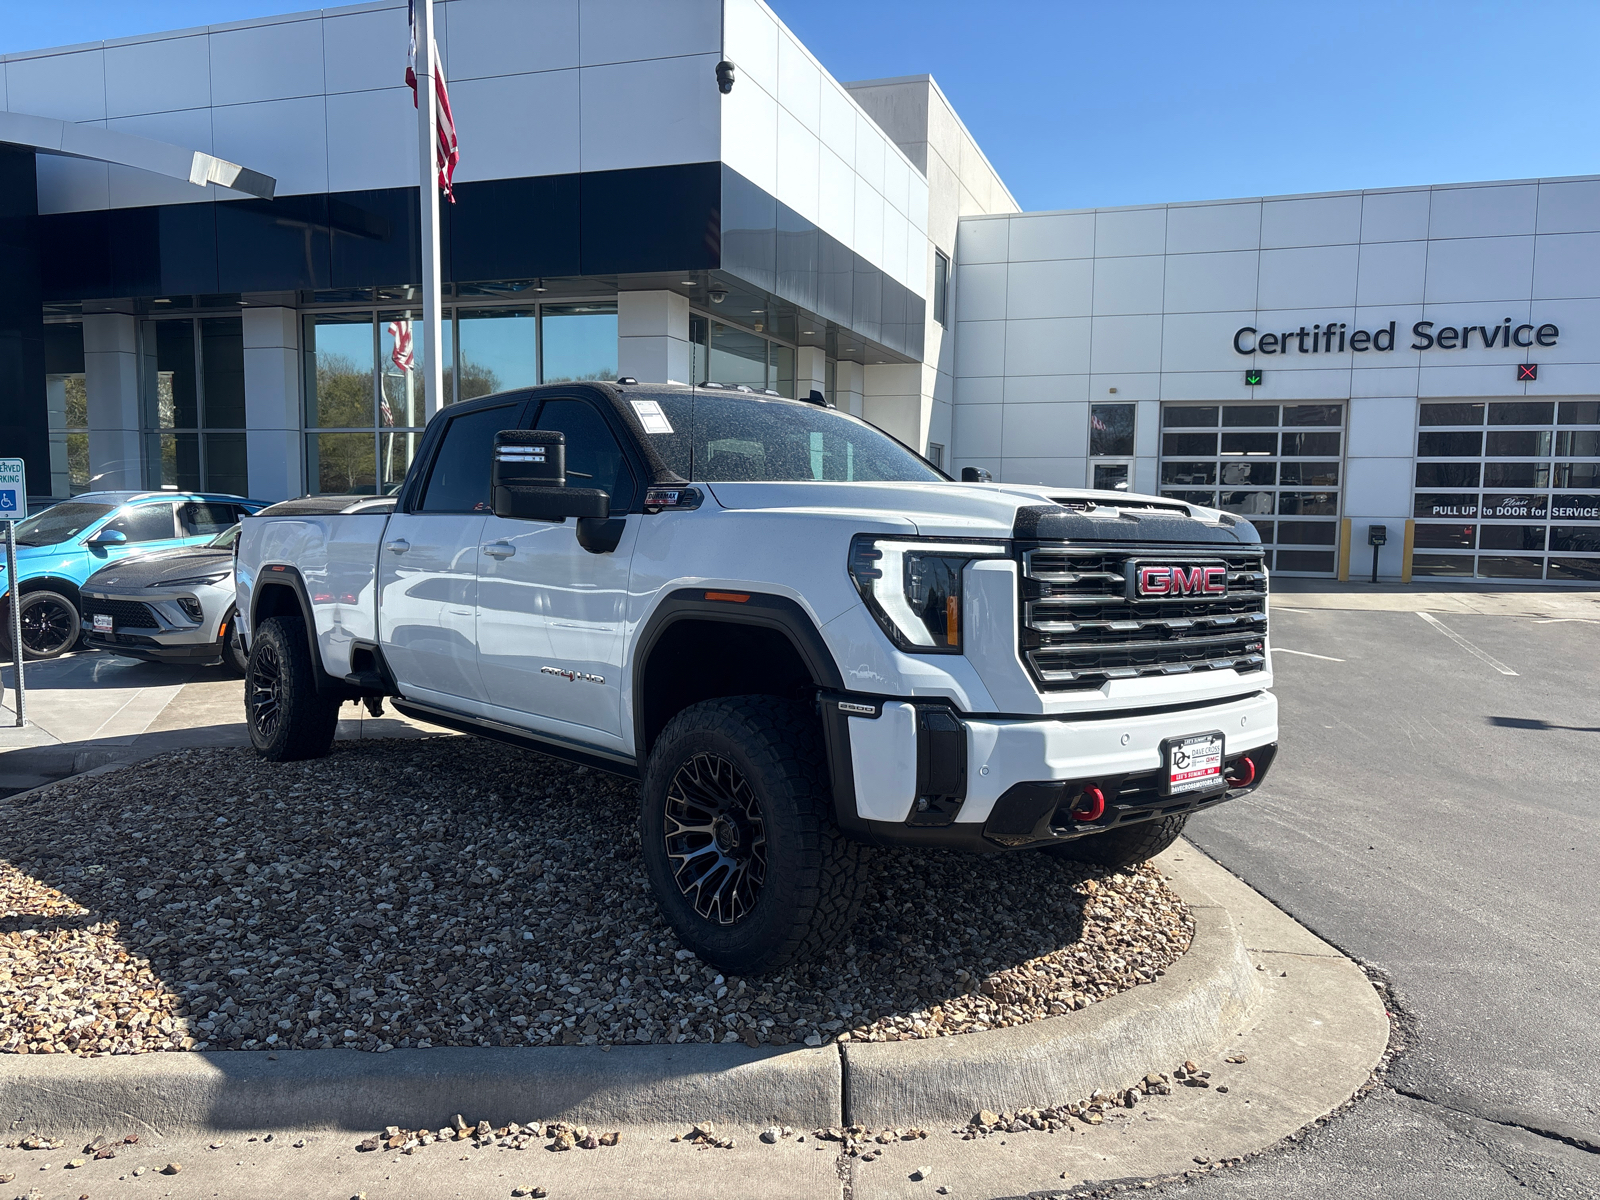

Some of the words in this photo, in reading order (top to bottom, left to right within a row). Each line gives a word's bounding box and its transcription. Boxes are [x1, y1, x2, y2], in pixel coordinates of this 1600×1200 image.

[1233, 321, 1396, 355] Certified
[1411, 317, 1559, 350] Service
[1501, 497, 1529, 507] Please
[1432, 506, 1459, 515] PULL
[1461, 506, 1477, 515] UP
[1483, 507, 1492, 516] to
[1496, 507, 1527, 516] DOOR
[1531, 507, 1546, 516] for
[1552, 507, 1599, 517] SERVICE
[1138, 566, 1226, 595] GMC
[541, 666, 575, 682] AT4
[577, 671, 606, 684] HD
[840, 703, 873, 712] 2500
[1192, 748, 1205, 756] DAVE
[1205, 745, 1220, 754] CROSS
